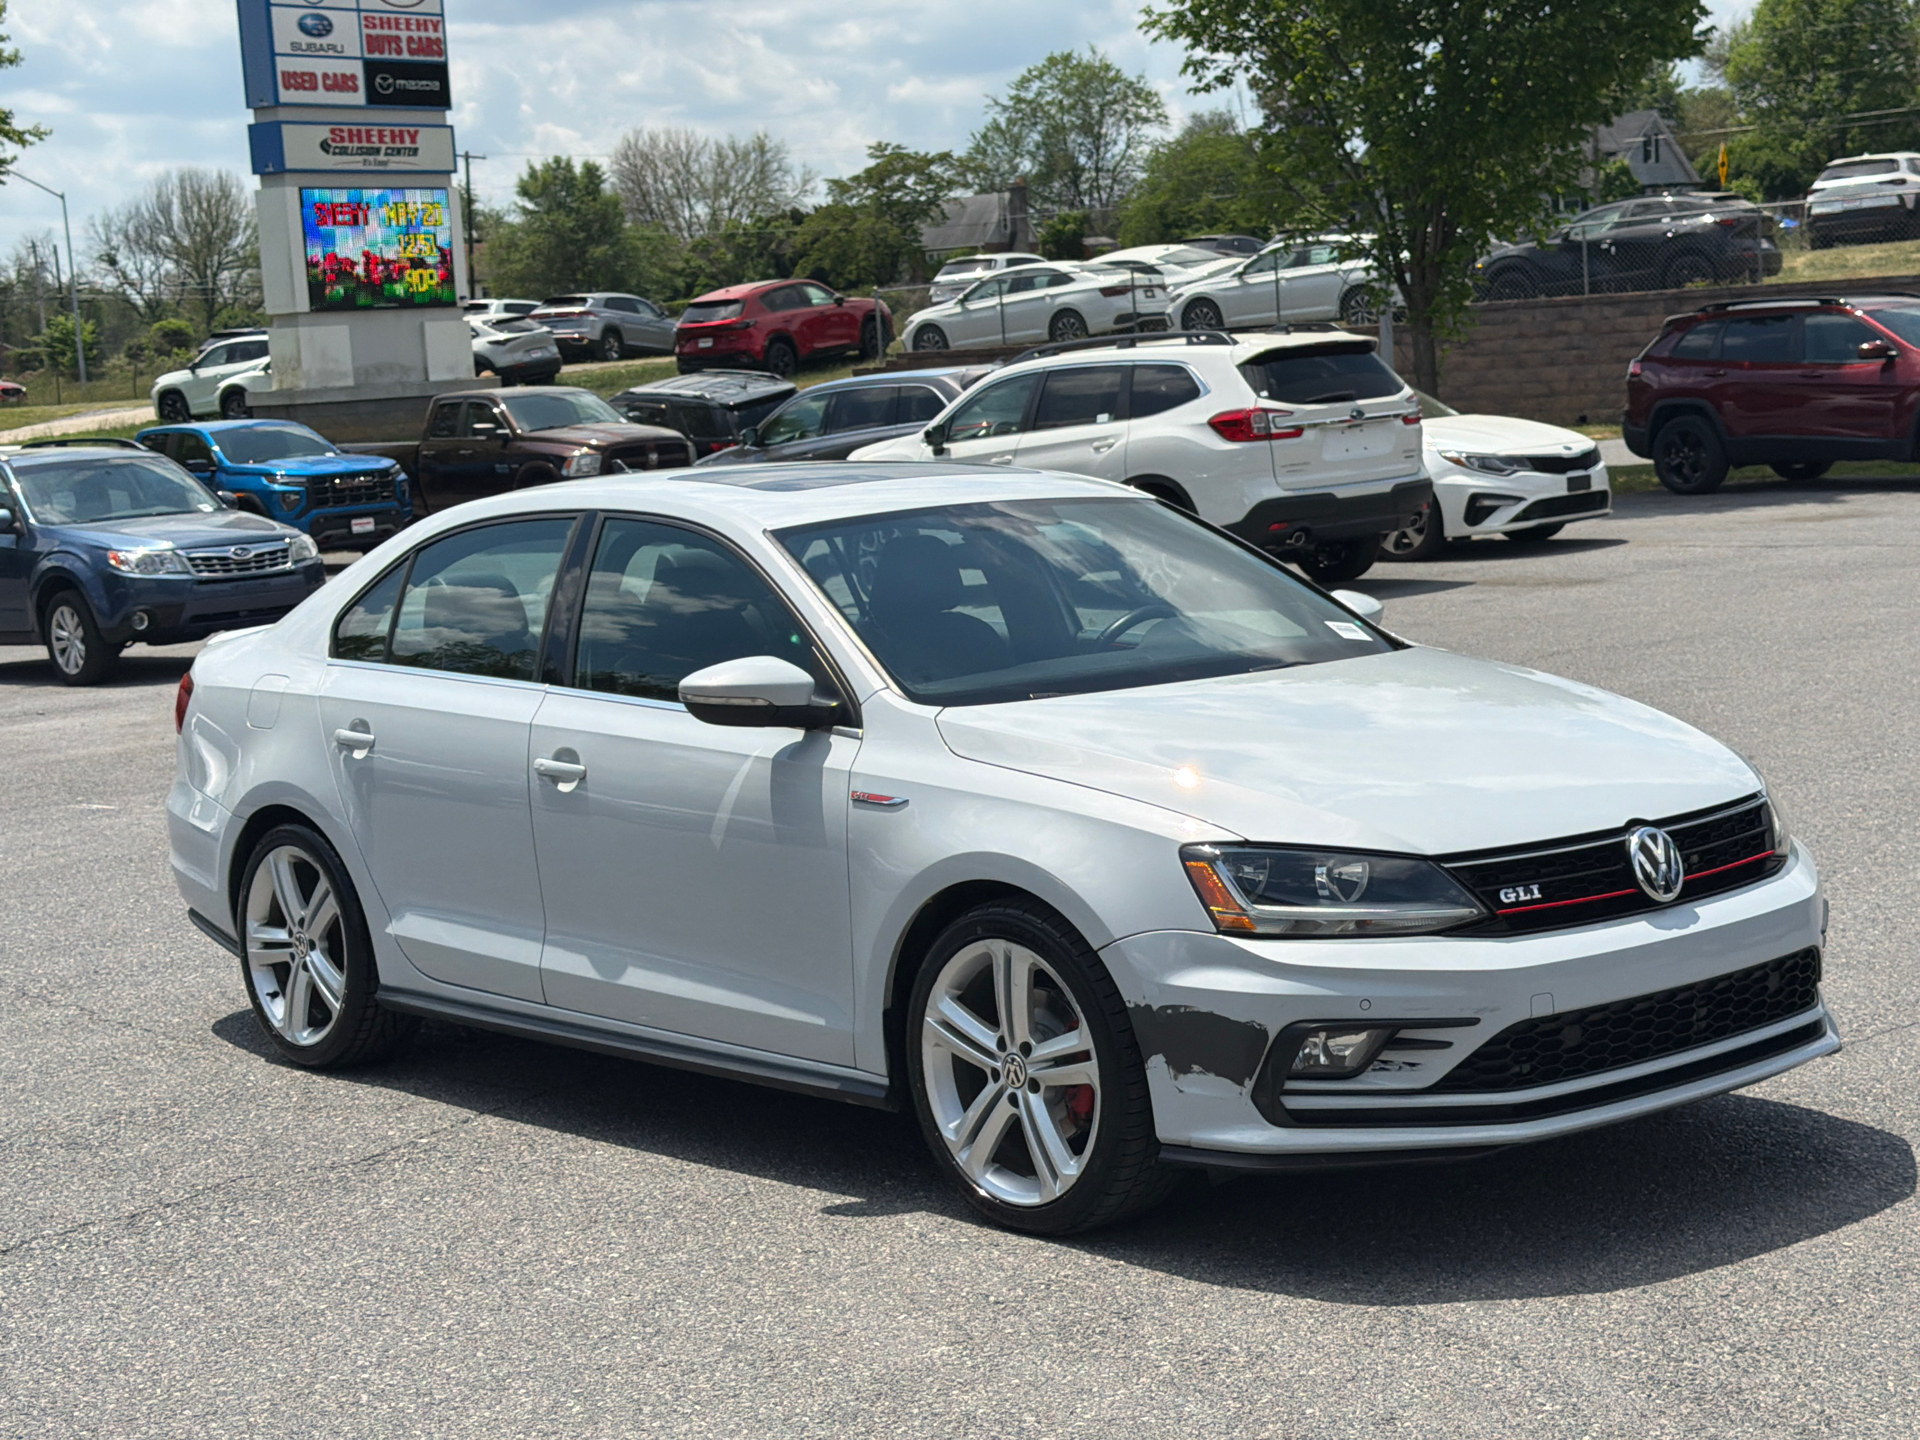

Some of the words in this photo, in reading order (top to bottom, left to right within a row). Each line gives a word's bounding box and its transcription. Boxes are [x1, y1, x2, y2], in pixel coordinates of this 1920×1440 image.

[363, 15, 441, 33] SHEEHY
[290, 41, 345, 54] SUBARU
[365, 33, 402, 56] BUYS
[406, 35, 443, 58] CARS
[280, 70, 319, 91] USED
[322, 72, 359, 93] CARS
[329, 127, 419, 145] SHEEHY
[331, 145, 381, 156] COLLISION
[384, 146, 419, 157] CENTER
[314, 202, 369, 226] SHEEHY
[384, 202, 418, 226] MAY
[421, 203, 443, 226] 20
[1499, 883, 1542, 904] GLI
